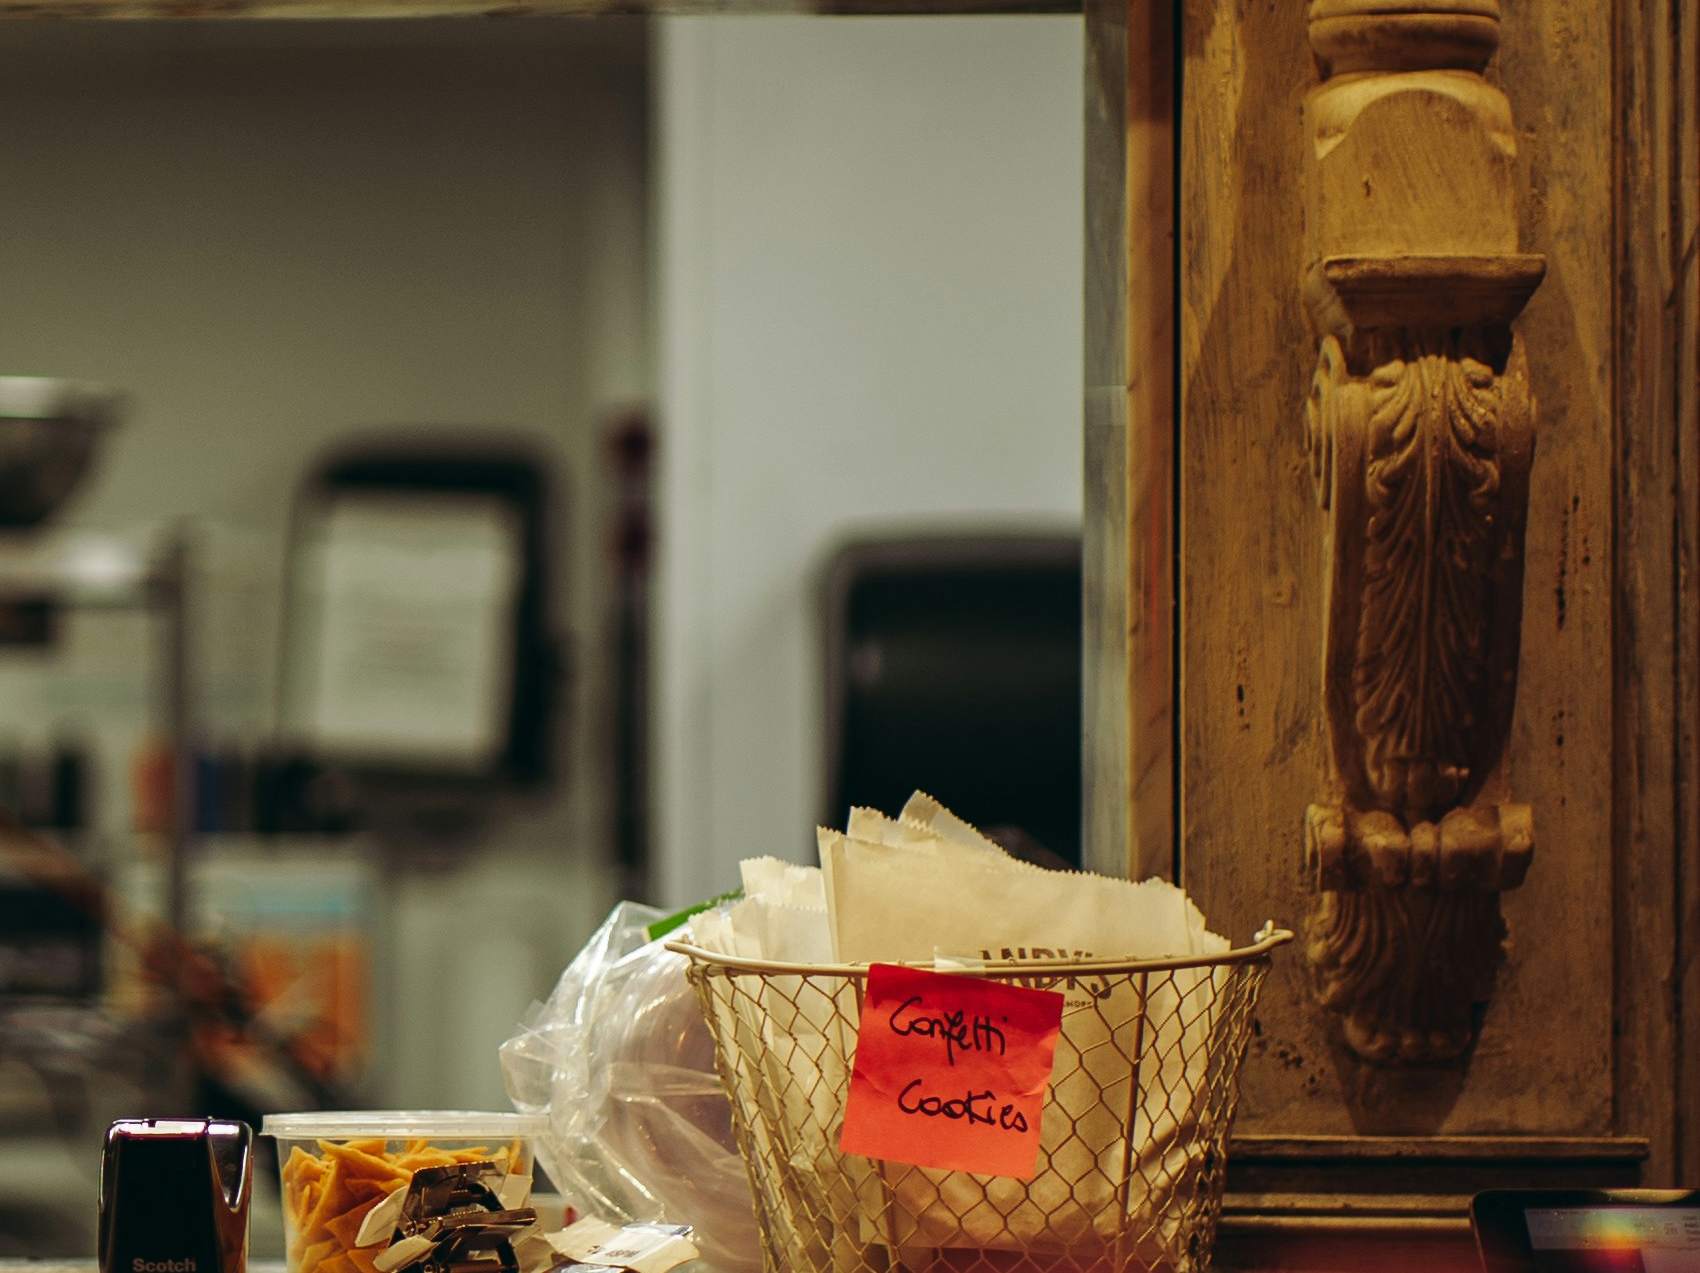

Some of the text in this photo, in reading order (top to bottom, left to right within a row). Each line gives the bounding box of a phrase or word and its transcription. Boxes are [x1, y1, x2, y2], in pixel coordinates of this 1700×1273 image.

[889, 996, 1009, 1067] Confetti
[898, 1079, 1029, 1133] Cookies
[132, 1257, 197, 1273] Scotch
